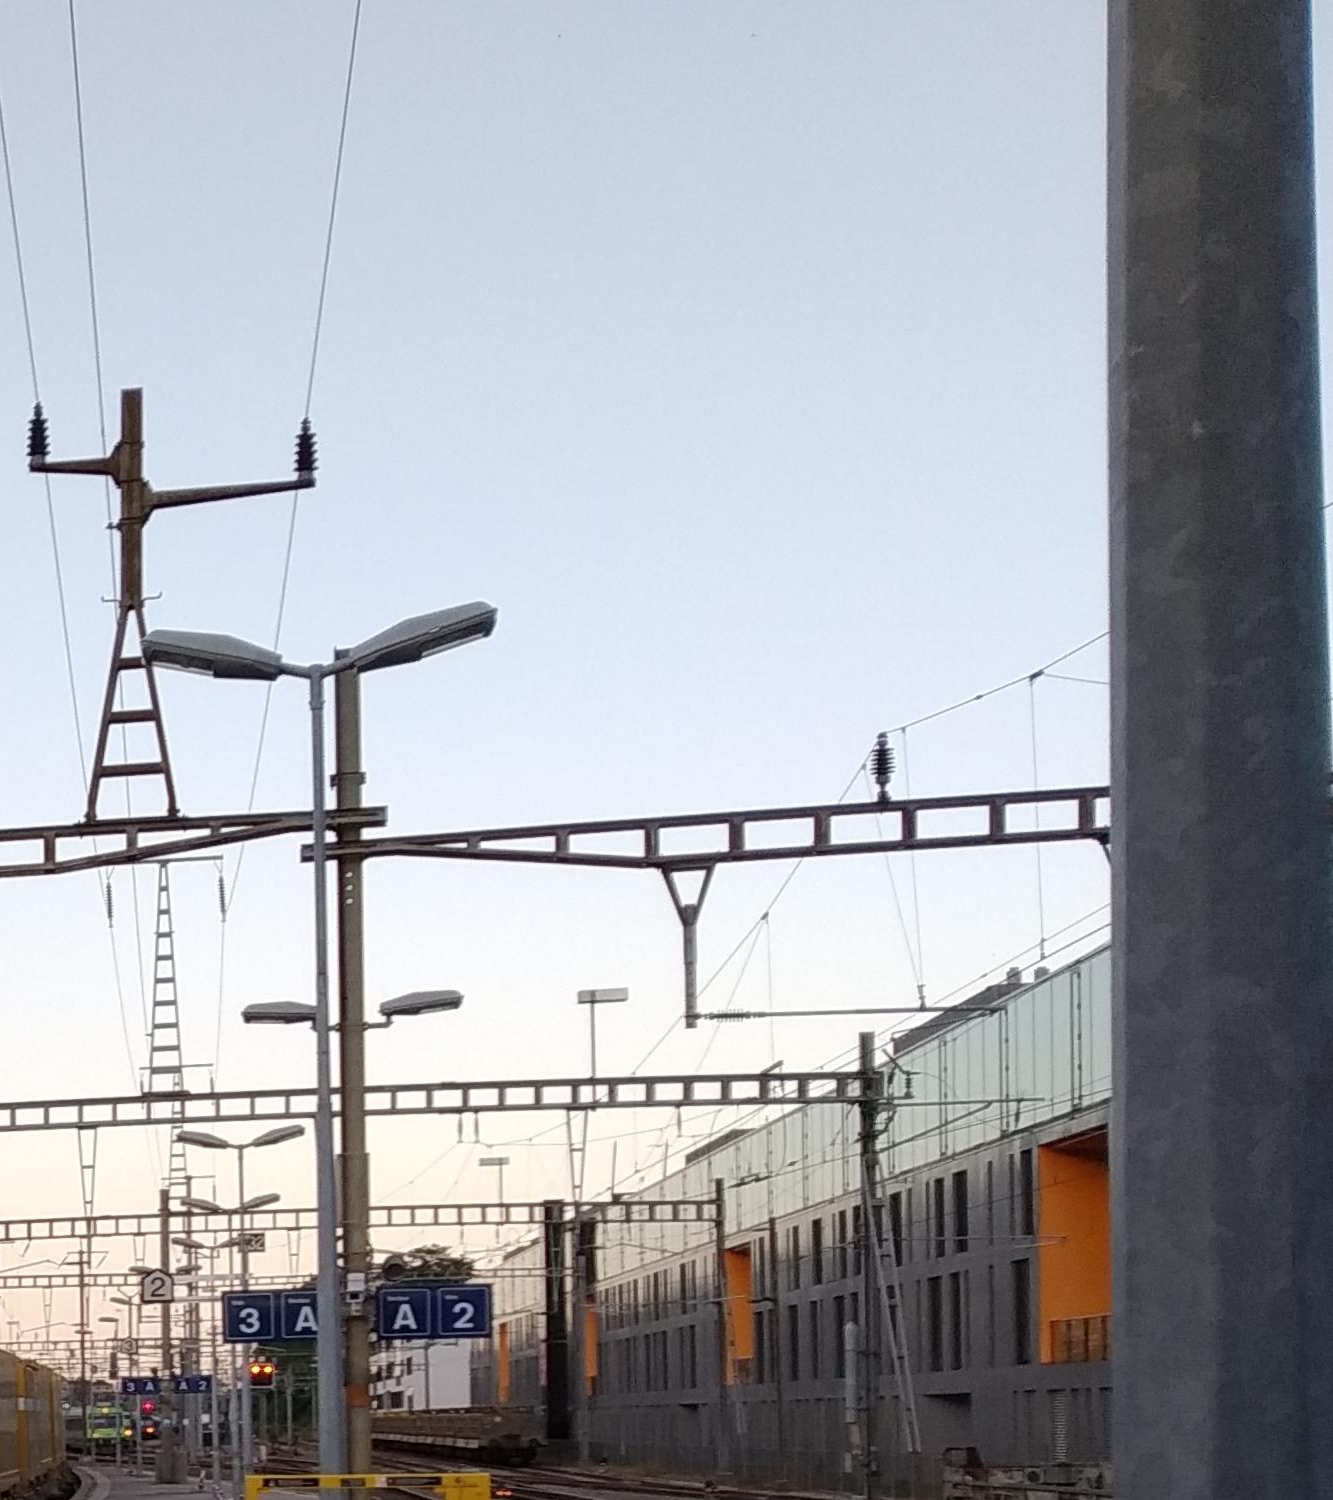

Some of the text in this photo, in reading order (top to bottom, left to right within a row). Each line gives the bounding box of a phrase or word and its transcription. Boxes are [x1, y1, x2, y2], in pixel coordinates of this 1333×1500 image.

[150, 1276, 166, 1297] 2
[238, 1306, 318, 1333] 3 A
[392, 1301, 475, 1330] A 2
[126, 1382, 155, 1392] 3 A
[179, 1380, 207, 1391] A 2
